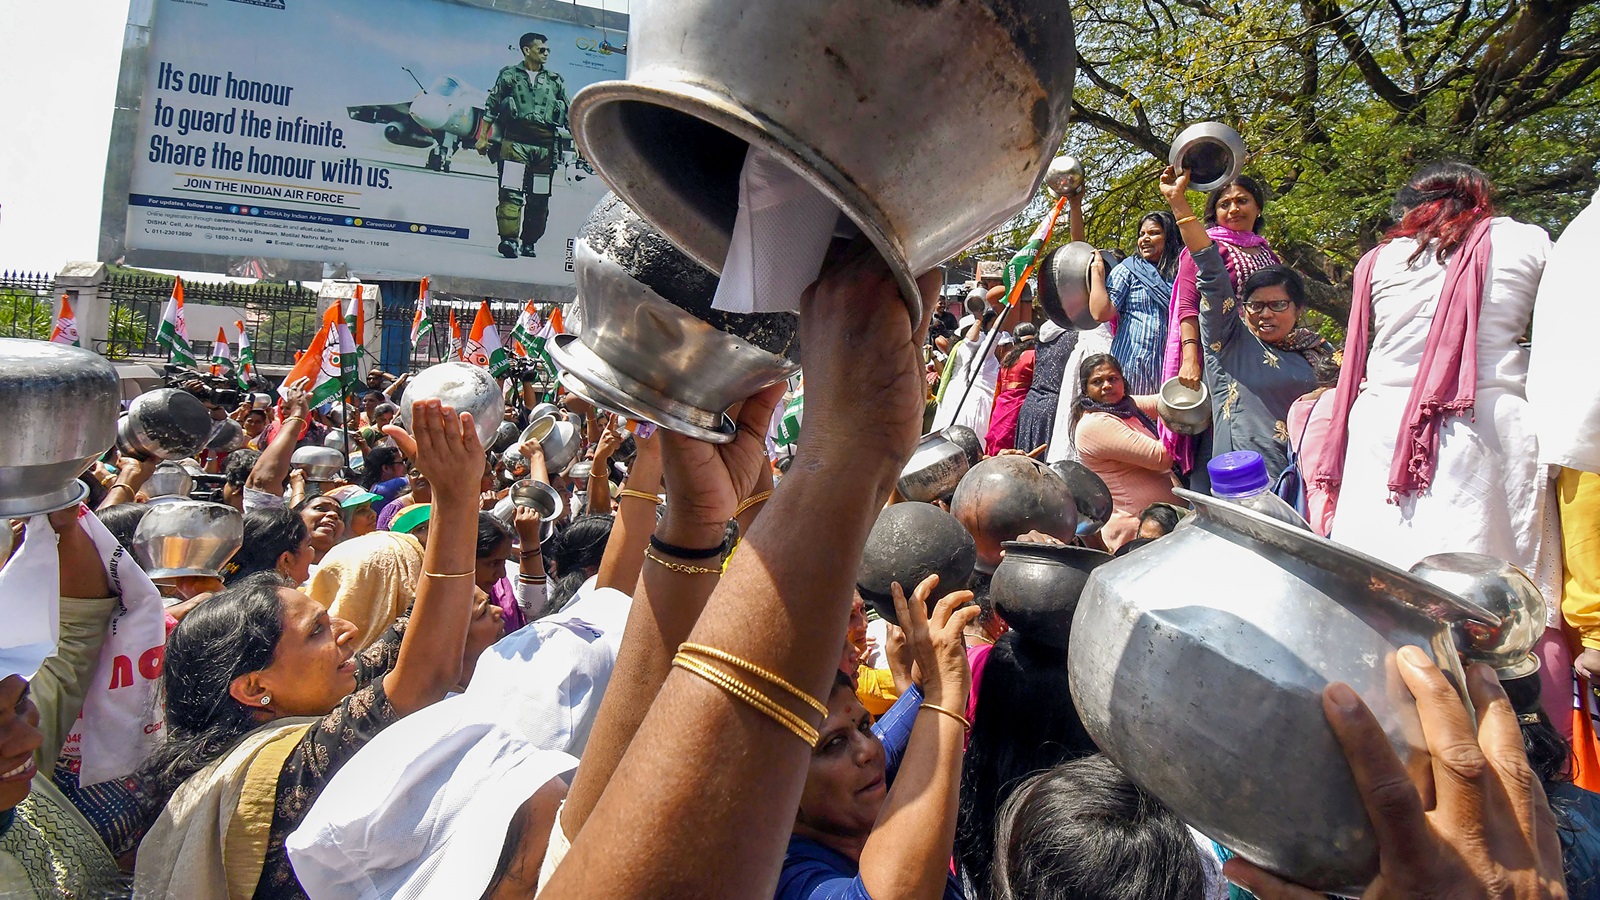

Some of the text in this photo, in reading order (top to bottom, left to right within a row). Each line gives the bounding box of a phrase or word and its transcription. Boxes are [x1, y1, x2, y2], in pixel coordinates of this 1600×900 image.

[158, 62, 294, 107] Its our honour
[154, 98, 346, 149] to guard the infinite.
[148, 134, 393, 190] Share the honour with us.
[184, 178, 344, 204] JOIN THE INDIAN AIR FORCE
[159, 199, 186, 208] updates,
[164, 212, 193, 220] registration
[193, 214, 213, 222] through
[194, 223, 237, 233] Headquarters,
[254, 229, 279, 237] Bhawan,
[280, 231, 301, 239] Motilal
[301, 233, 319, 241] Nehru
[110, 558, 119, 580] FAMILY
